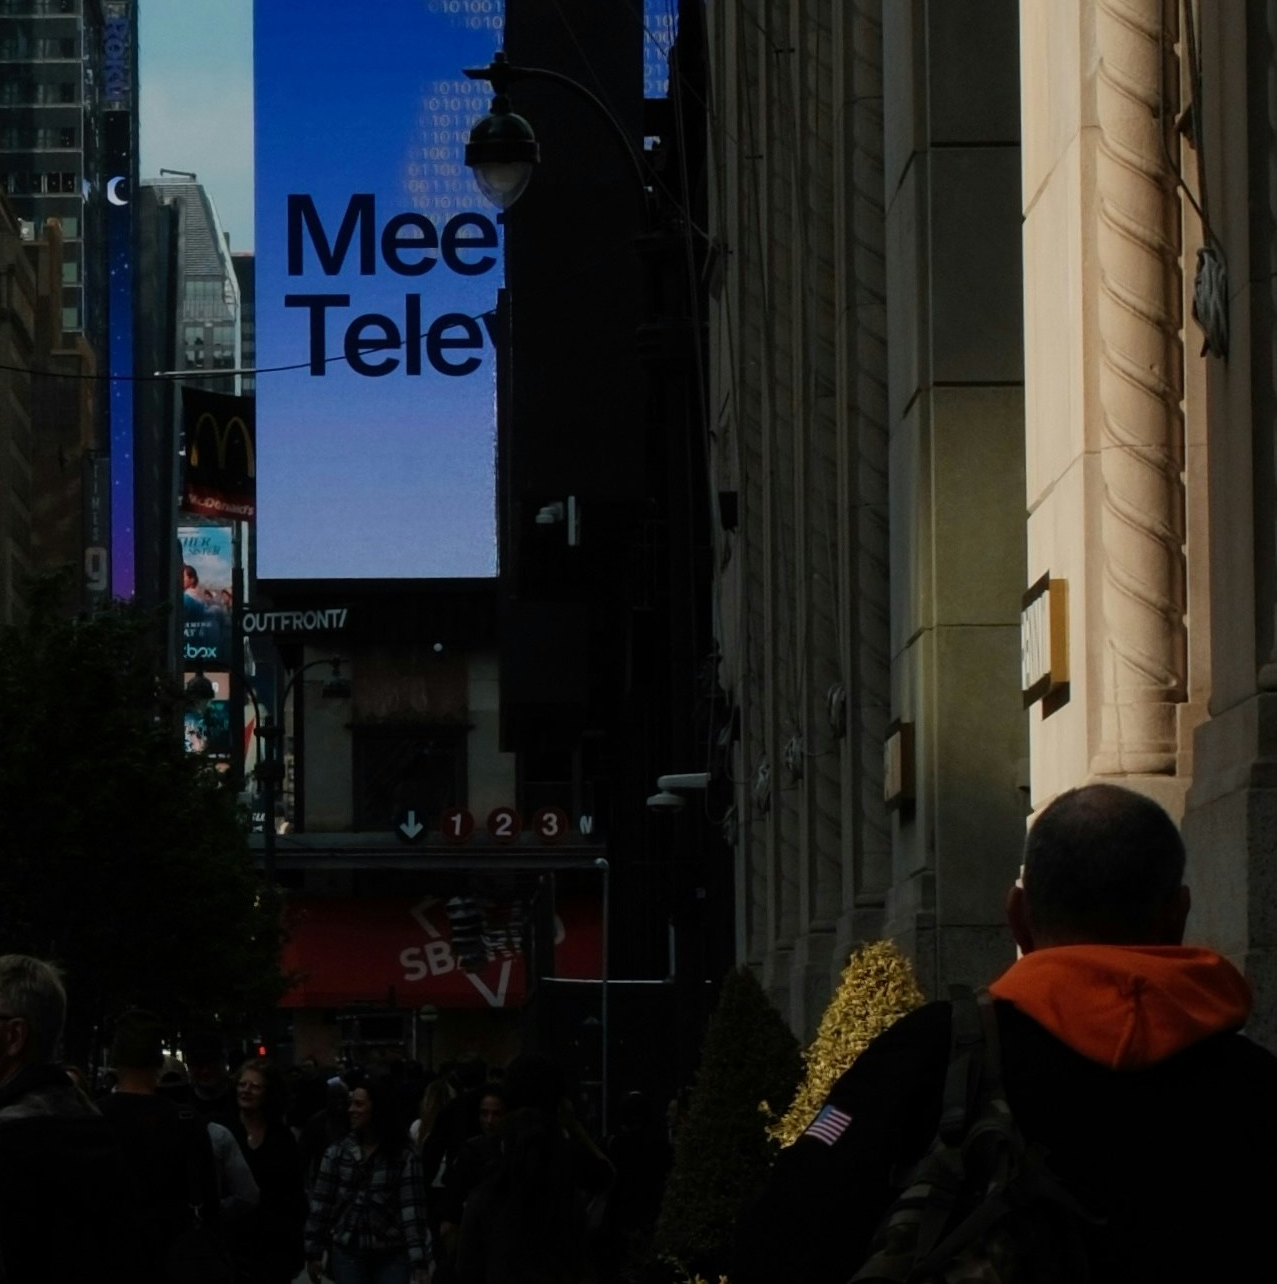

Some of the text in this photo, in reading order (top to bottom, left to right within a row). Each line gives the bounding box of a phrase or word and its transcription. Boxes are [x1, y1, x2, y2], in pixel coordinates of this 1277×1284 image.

[183, 642, 217, 659] box
[450, 813, 462, 836] 1
[494, 813, 513, 836] 2
[541, 813, 559, 836] 3
